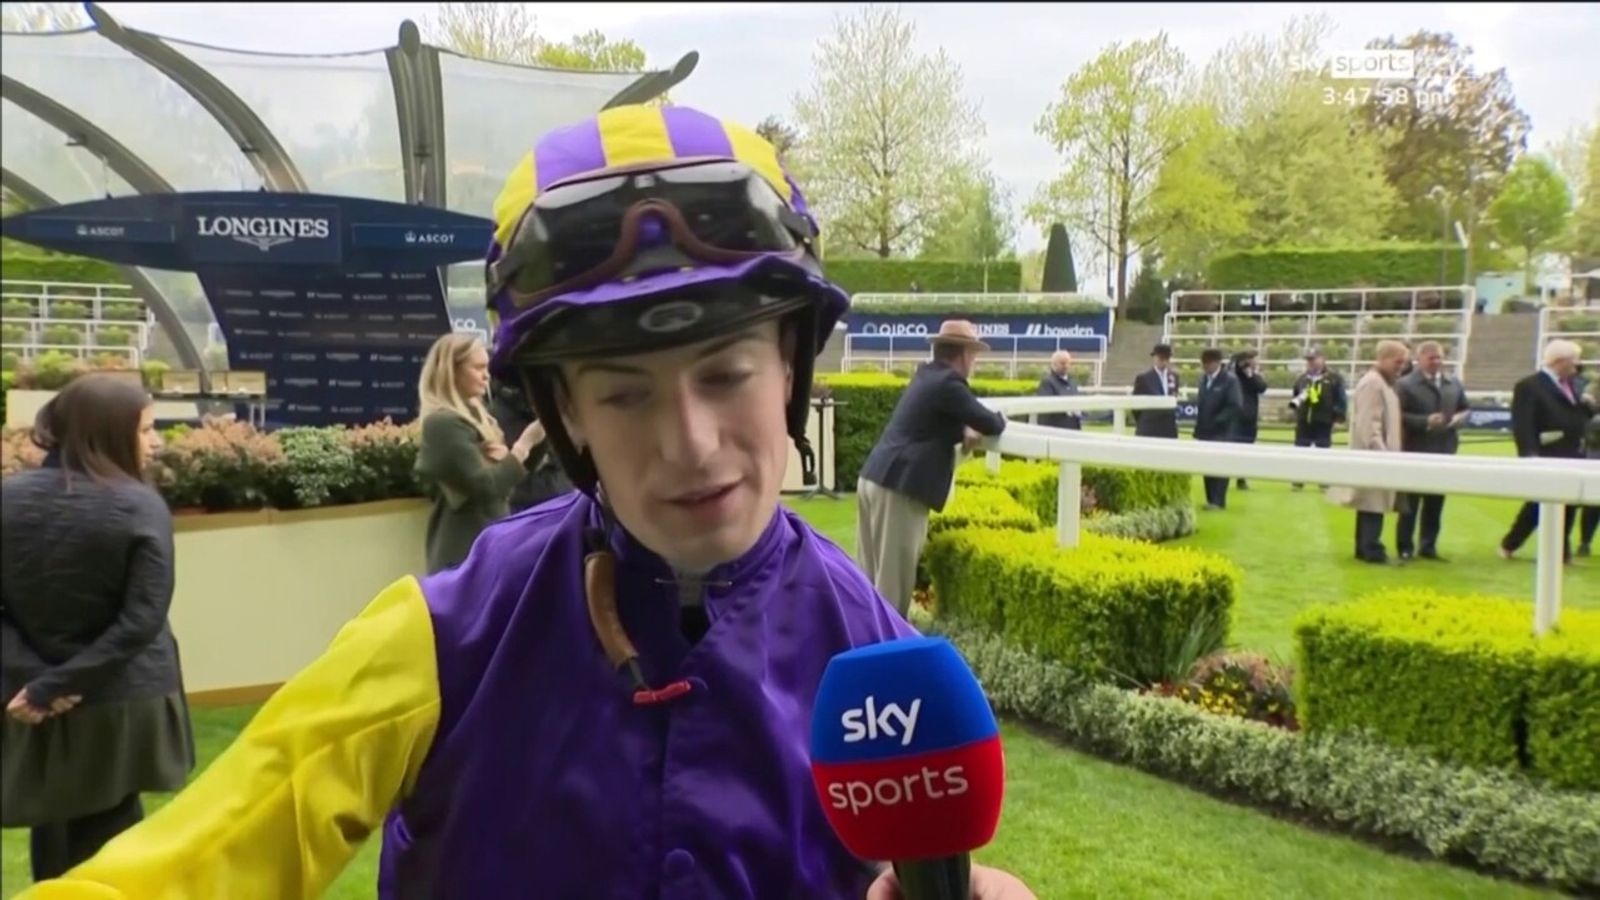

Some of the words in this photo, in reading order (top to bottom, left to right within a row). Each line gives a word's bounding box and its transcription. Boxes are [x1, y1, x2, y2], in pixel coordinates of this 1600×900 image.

[89, 226, 125, 237] ASCOT
[196, 215, 329, 239] LONGINES
[418, 233, 455, 244] ASCOT
[841, 695, 922, 746] sky
[828, 765, 969, 816] sports
